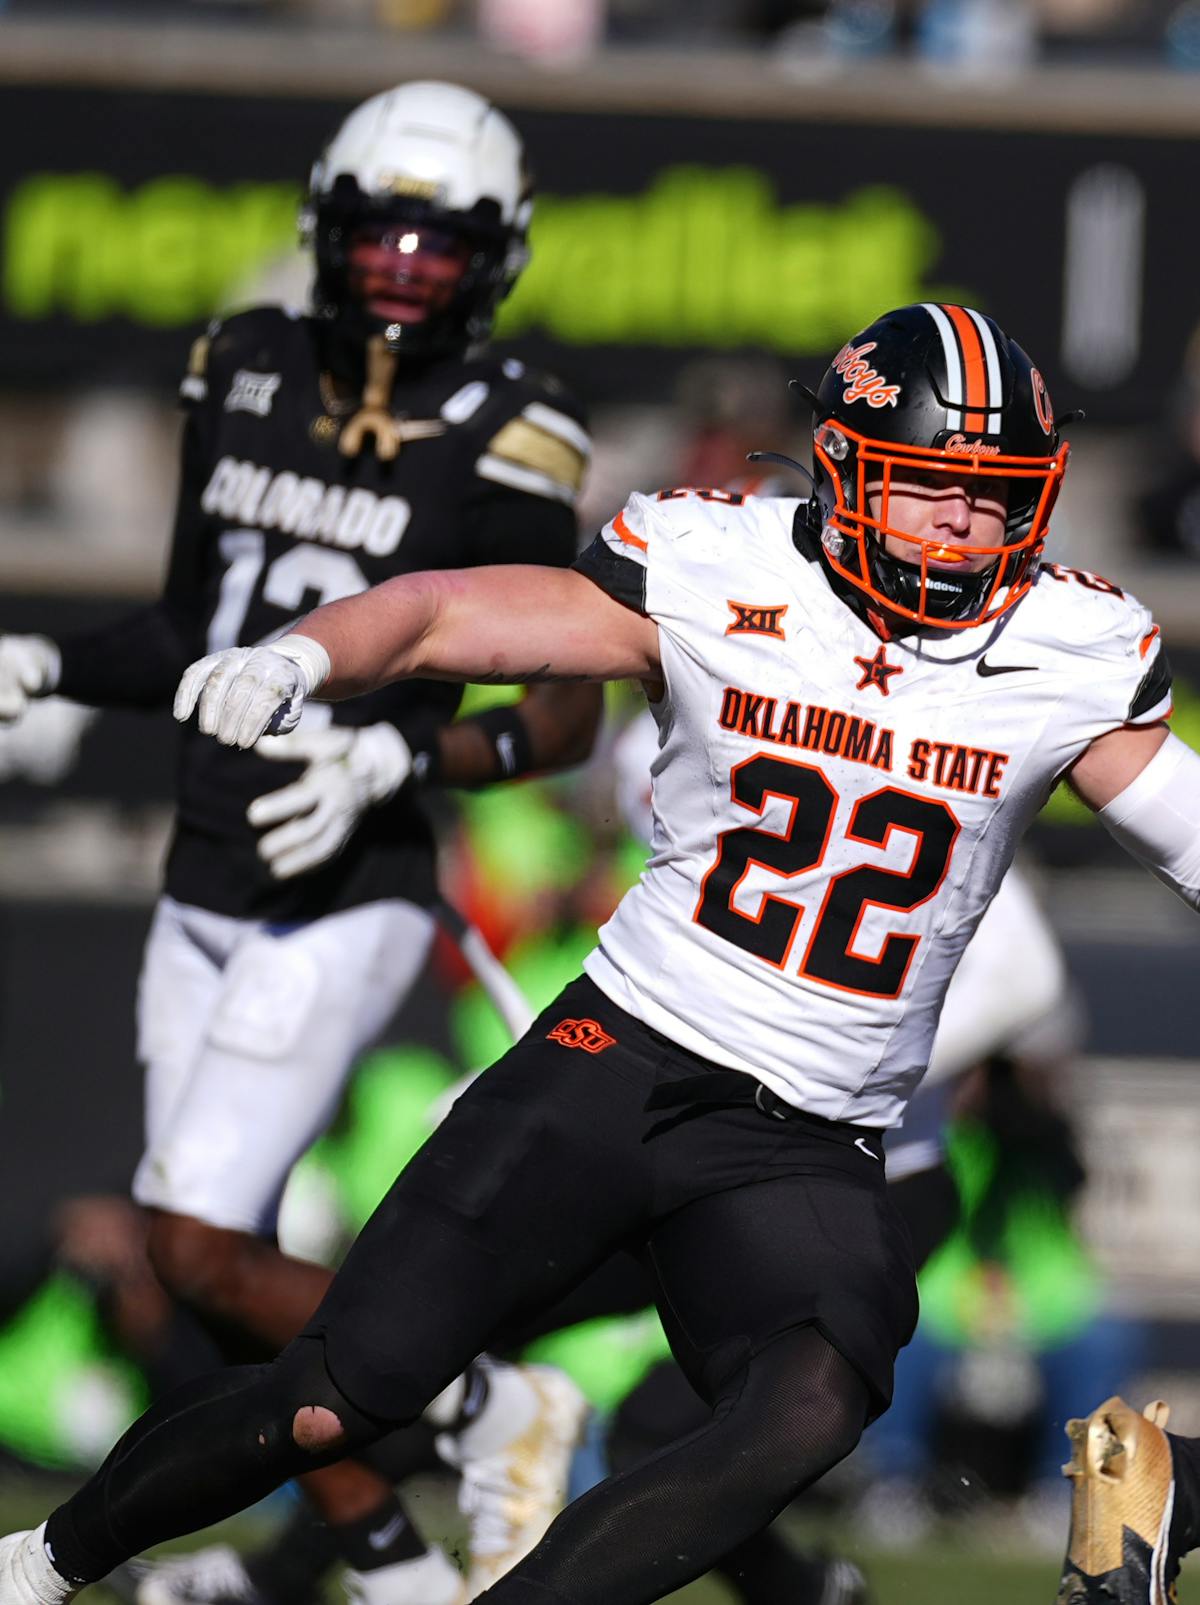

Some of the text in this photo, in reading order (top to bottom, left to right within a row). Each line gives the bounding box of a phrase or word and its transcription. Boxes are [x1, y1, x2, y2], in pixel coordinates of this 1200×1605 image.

[201, 455, 411, 557] COLORADO
[732, 606, 783, 635] XII
[717, 687, 894, 771] OKLAHOMA
[907, 739, 1009, 798] STATE
[693, 752, 961, 999] 22
